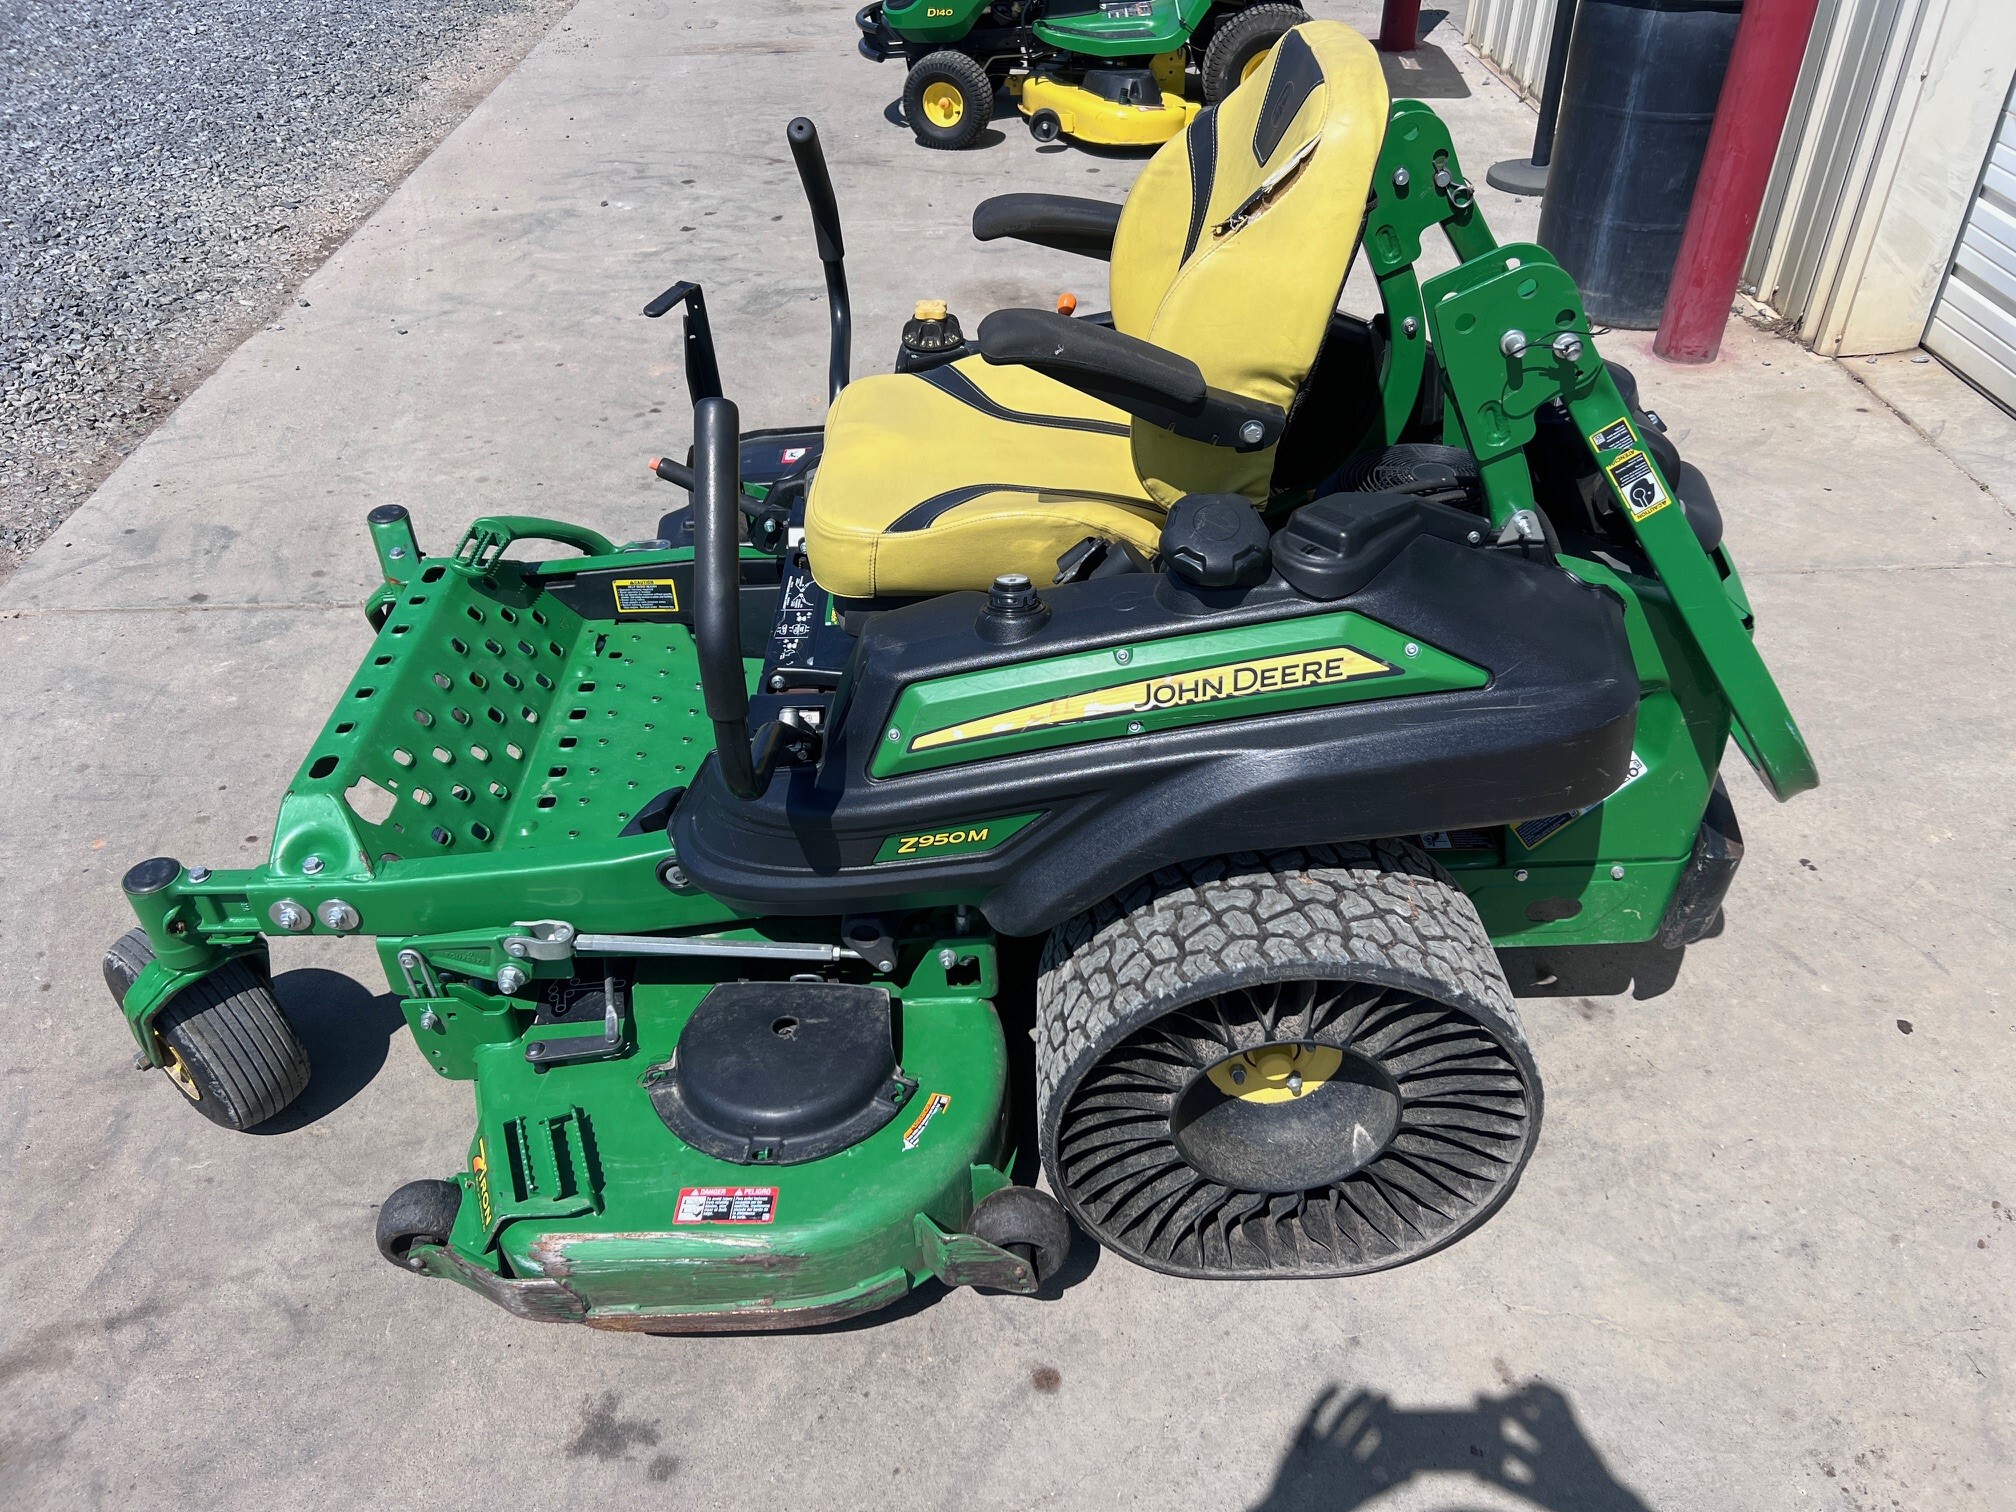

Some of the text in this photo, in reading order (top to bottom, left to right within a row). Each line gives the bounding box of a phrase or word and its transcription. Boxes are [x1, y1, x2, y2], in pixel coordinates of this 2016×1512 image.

[927, 8, 954, 17] D140
[1135, 657, 1345, 708] JOHN DEERE
